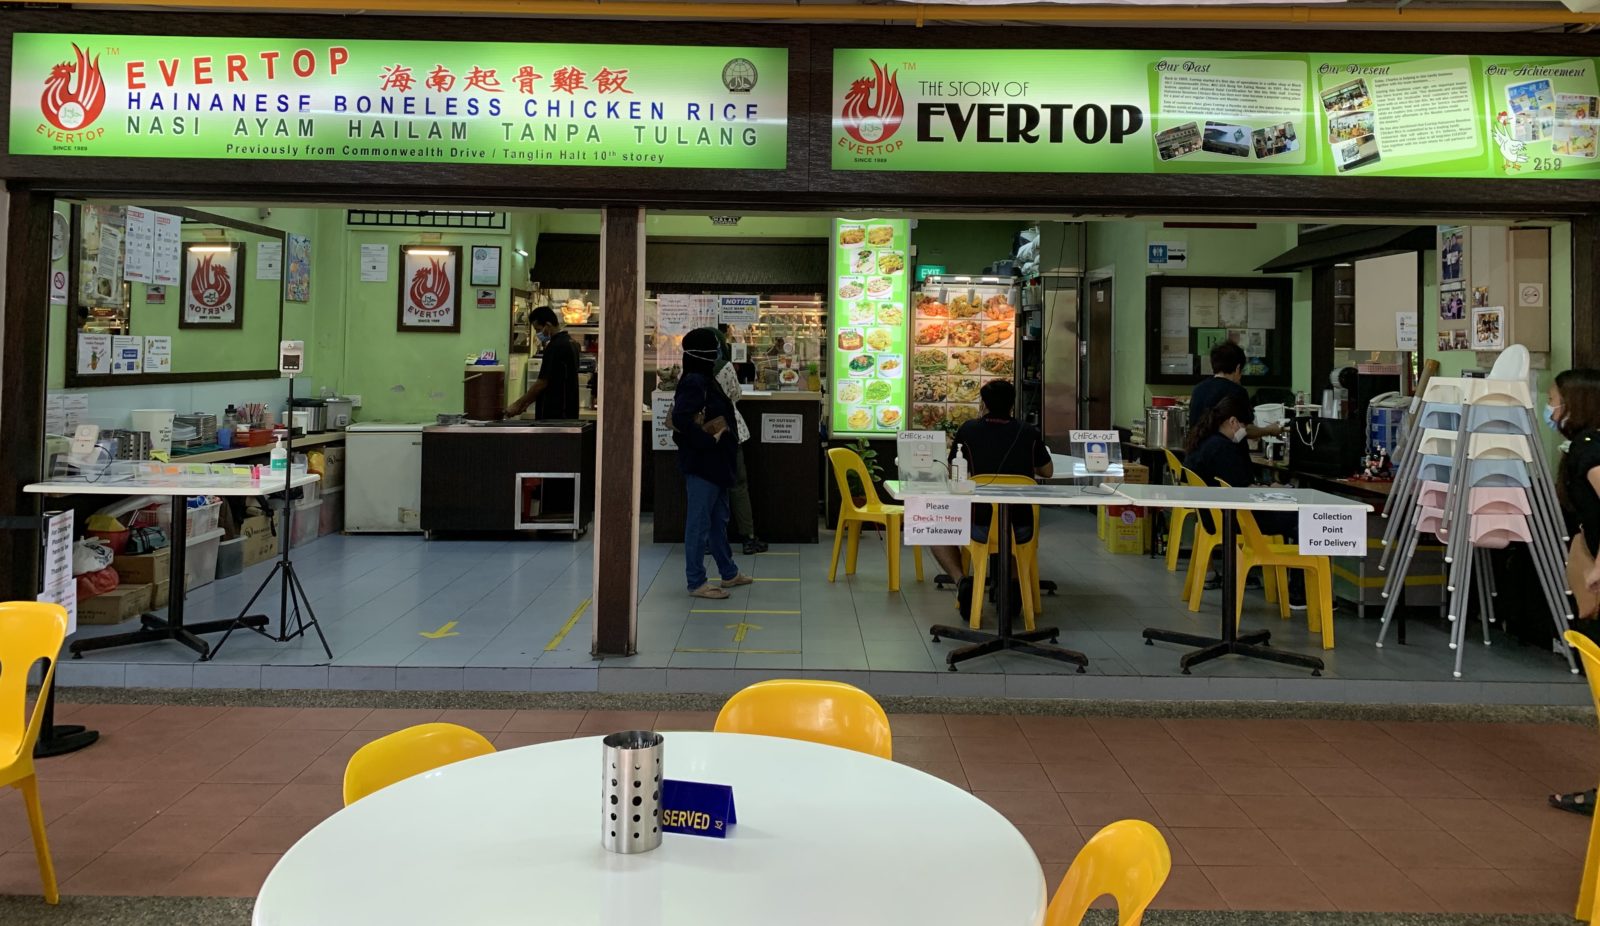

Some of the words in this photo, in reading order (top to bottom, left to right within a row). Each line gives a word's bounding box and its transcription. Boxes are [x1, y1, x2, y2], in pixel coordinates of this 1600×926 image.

[126, 47, 350, 89] EVERTOP
[903, 62, 916, 70] TM
[1155, 60, 1179, 72] Our
[1183, 61, 1210, 72] Past
[1318, 64, 1340, 74] Our
[1346, 64, 1390, 75] Present
[1486, 64, 1507, 76] Our
[1513, 66, 1586, 77] Achievement
[379, 64, 633, 95] 海南起骨雞飯
[918, 81, 943, 96] THE
[948, 81, 1000, 96] STORY
[1004, 81, 1030, 97] OF
[128, 92, 310, 112] HAINANESE
[334, 96, 502, 117] BONELESS
[524, 99, 664, 120] CHICKEN
[687, 102, 758, 122] RICE
[917, 103, 1143, 144] EVERTOP
[36, 123, 104, 144] EVERTOP
[127, 116, 200, 135] NASI
[234, 118, 314, 137] AYAM
[348, 120, 467, 140] HAILAM
[502, 122, 601, 144] TANPA
[634, 126, 757, 146] TULANG
[838, 137, 904, 155] EVERTOP
[226, 144, 298, 156] Previously
[305, 145, 335, 155] from
[342, 146, 443, 157] Commonwealth
[450, 148, 486, 158] Drive
[503, 149, 553, 161] Tanglin
[560, 150, 586, 160] Halt
[594, 151, 617, 162] 10th
[622, 152, 664, 163] storey
[1534, 158, 1561, 171] 259
[922, 269, 940, 278] EXIT
[408, 306, 450, 318] EVERTOP
[900, 432, 934, 440] CHECK-IN
[1073, 432, 1115, 440] CHECK-OUT
[1312, 512, 1352, 521] Collection
[926, 526, 962, 536] Takeaway
[1322, 526, 1343, 534] Point
[1324, 538, 1357, 548] Delivery
[662, 810, 710, 830] SERVED
